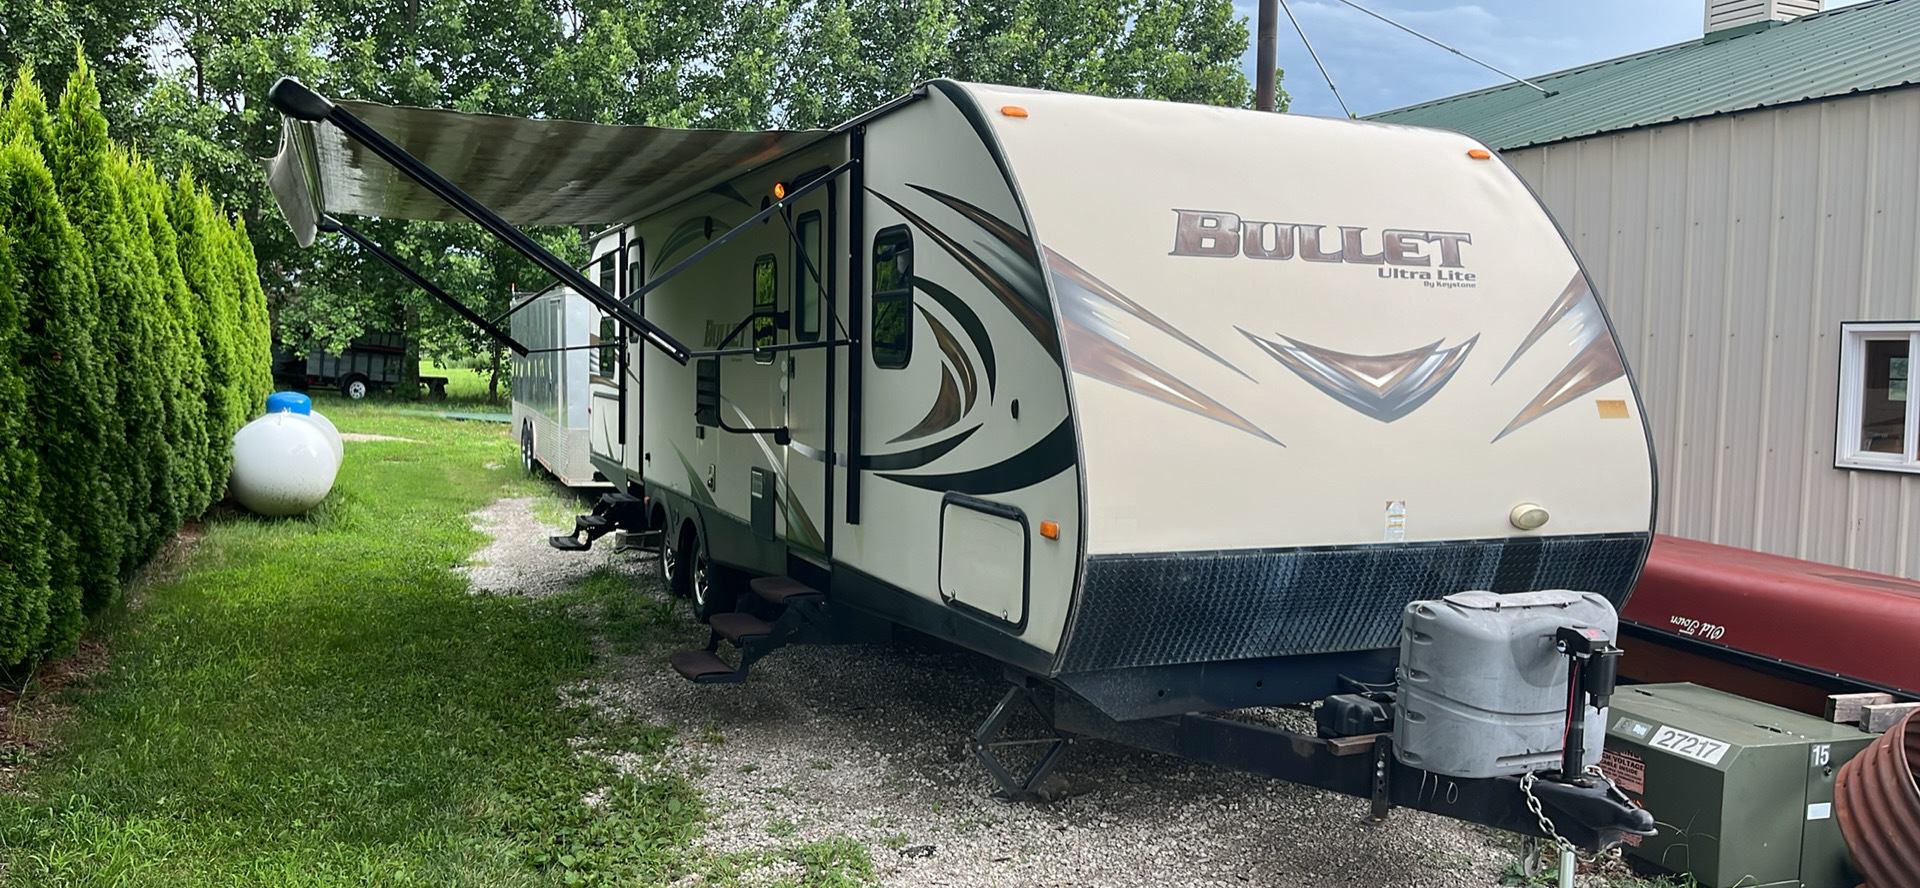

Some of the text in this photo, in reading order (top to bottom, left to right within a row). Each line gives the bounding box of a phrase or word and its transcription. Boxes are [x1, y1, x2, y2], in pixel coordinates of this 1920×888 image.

[1168, 208, 1472, 268] BULLET
[1378, 268, 1476, 281] Ultra Lite
[1423, 280, 1476, 289] By Keystone
[1670, 615, 1725, 640] Old Town
[1657, 730, 1721, 759] 27217
[1812, 744, 1831, 766] 15
[1612, 755, 1644, 770] VOLTAGE
